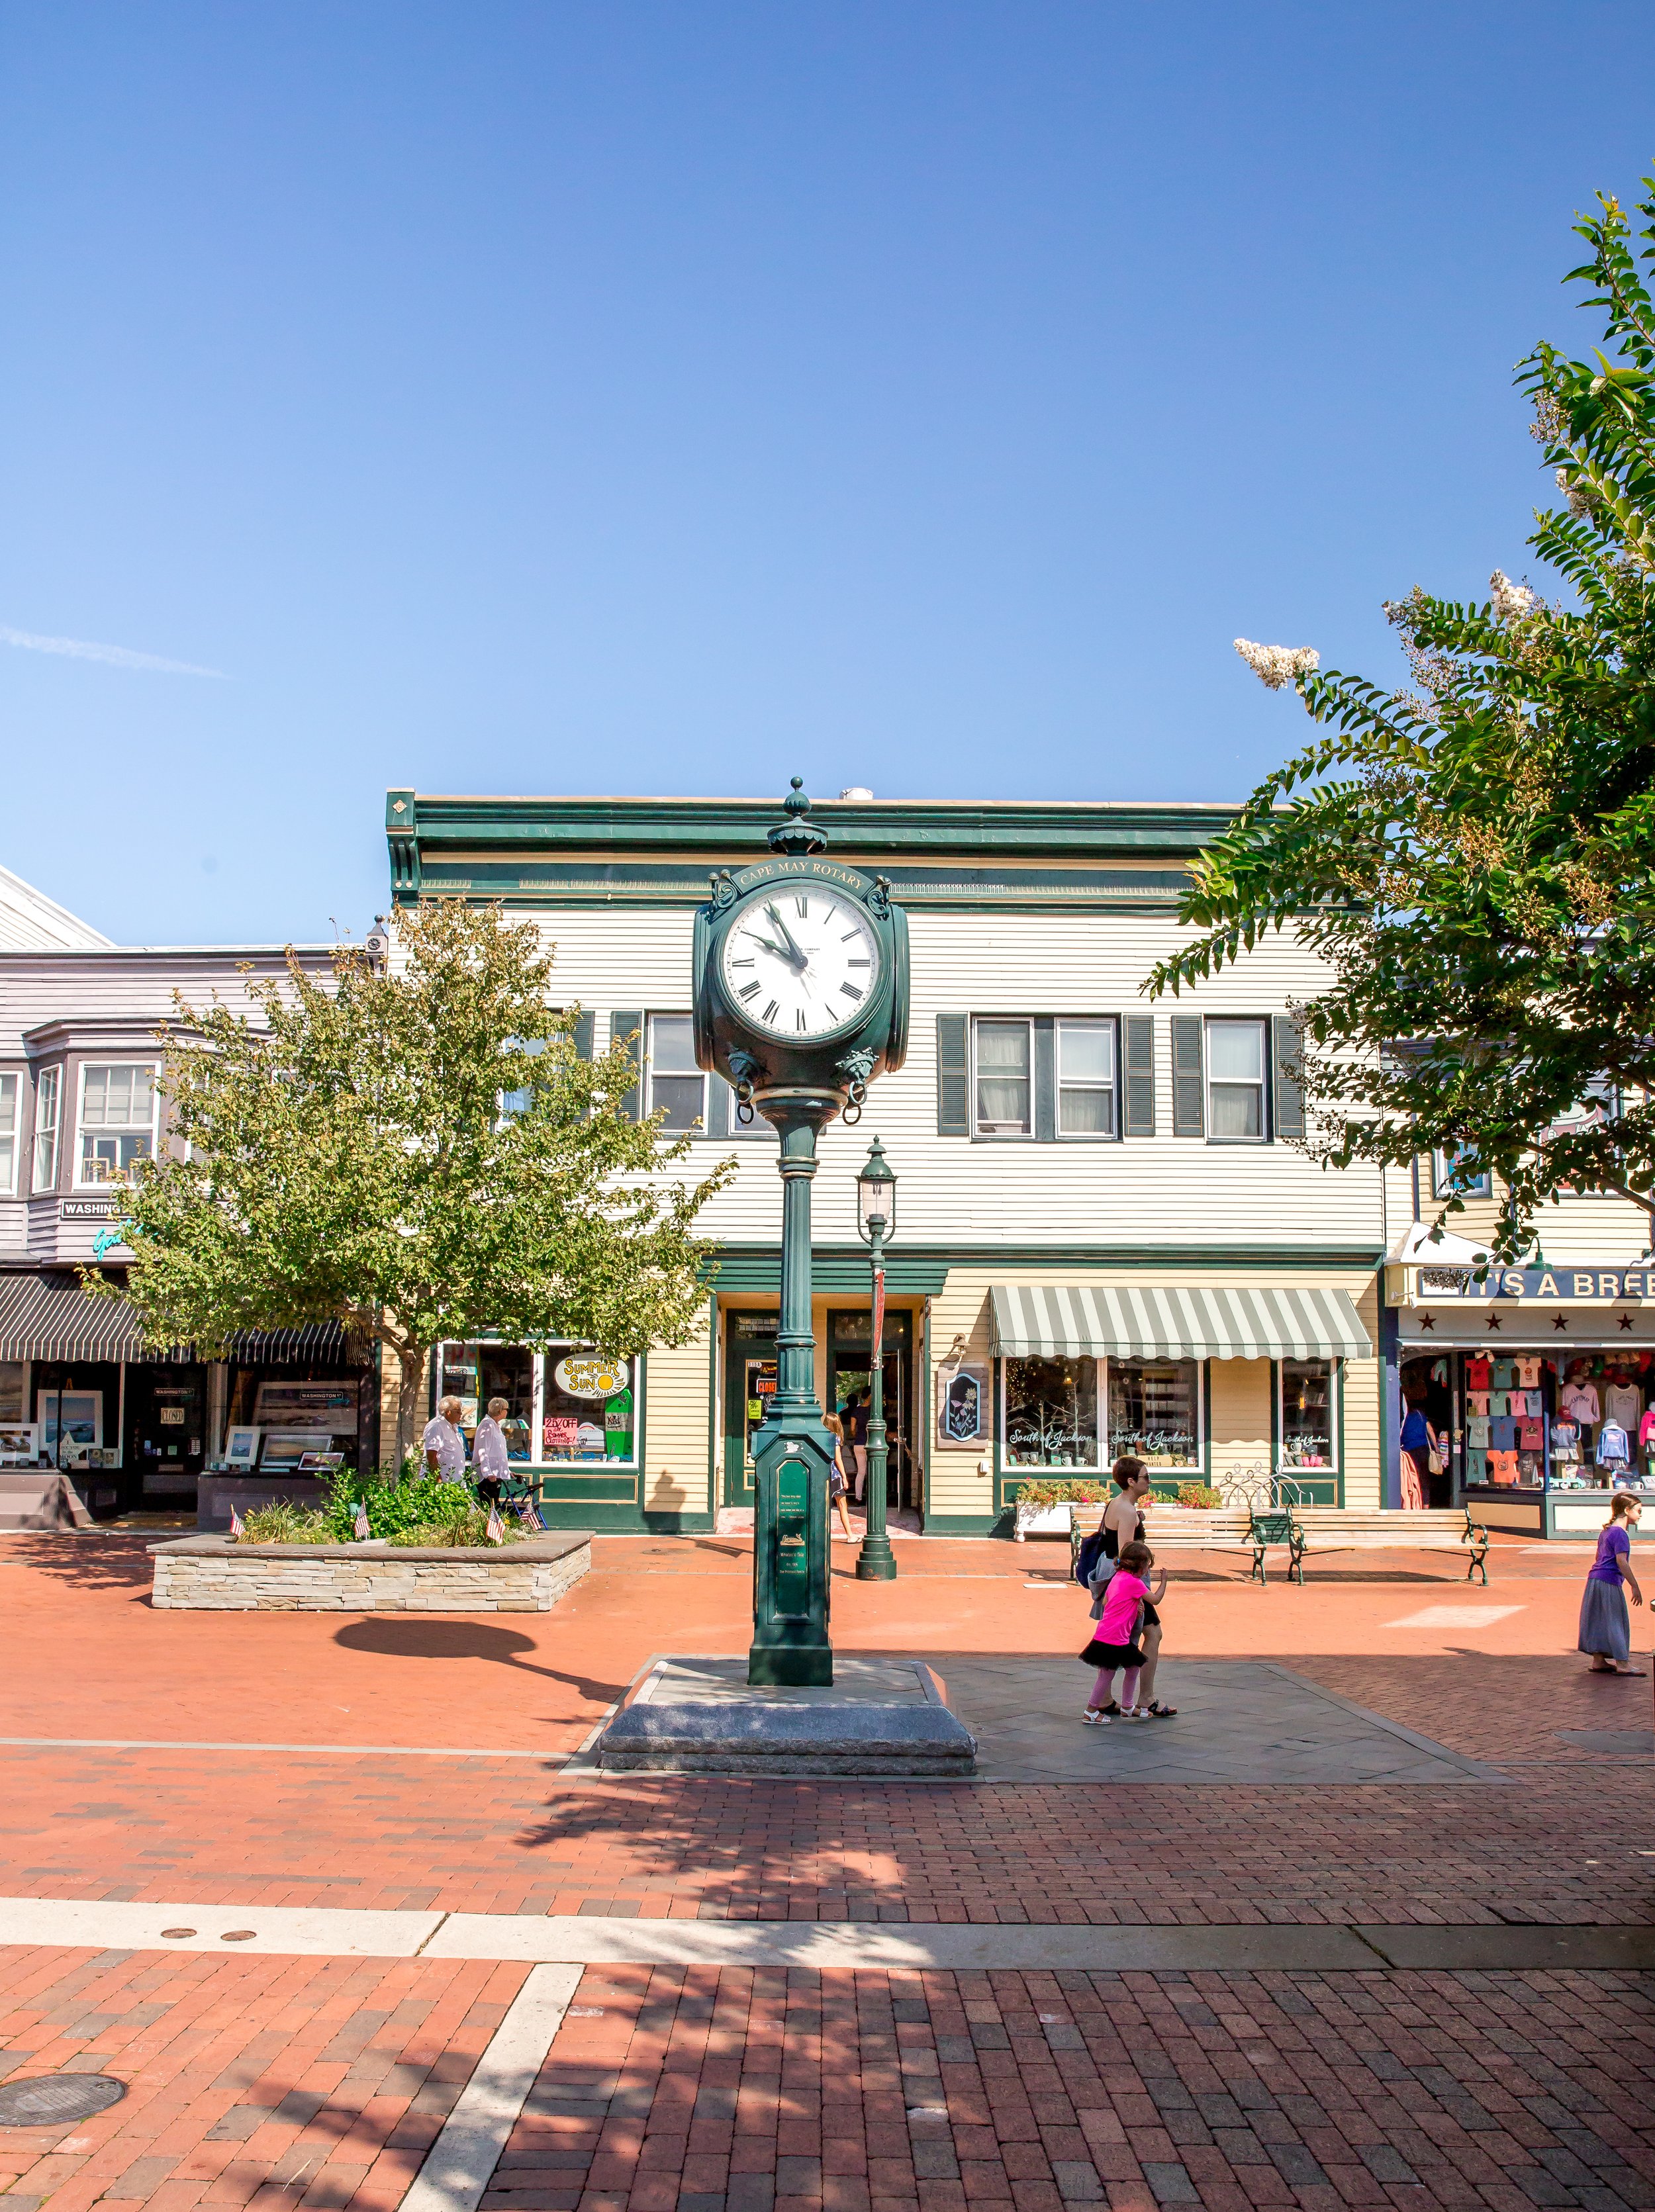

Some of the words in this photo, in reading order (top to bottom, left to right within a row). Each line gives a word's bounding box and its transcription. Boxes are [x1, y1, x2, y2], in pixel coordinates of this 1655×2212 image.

[740, 865, 775, 885] CAPE
[778, 862, 809, 872] MAY
[812, 863, 865, 890] ROTARY
[66, 1204, 130, 1214] WASHING
[1537, 1273, 1560, 1296] A
[564, 1359, 620, 1377] SUMMER
[569, 1374, 595, 1391] SUN
[759, 1382, 777, 1393] CLOSE
[545, 1418, 563, 1428] 25%
[563, 1418, 577, 1428] OFF
[1010, 1429, 1039, 1443] South
[1040, 1432, 1051, 1448] of
[1048, 1430, 1092, 1450] Jackson
[1111, 1430, 1142, 1444] South
[1141, 1432, 1153, 1449] of
[1149, 1430, 1194, 1450] Jackson
[1305, 1435, 1329, 1446] Jackson
